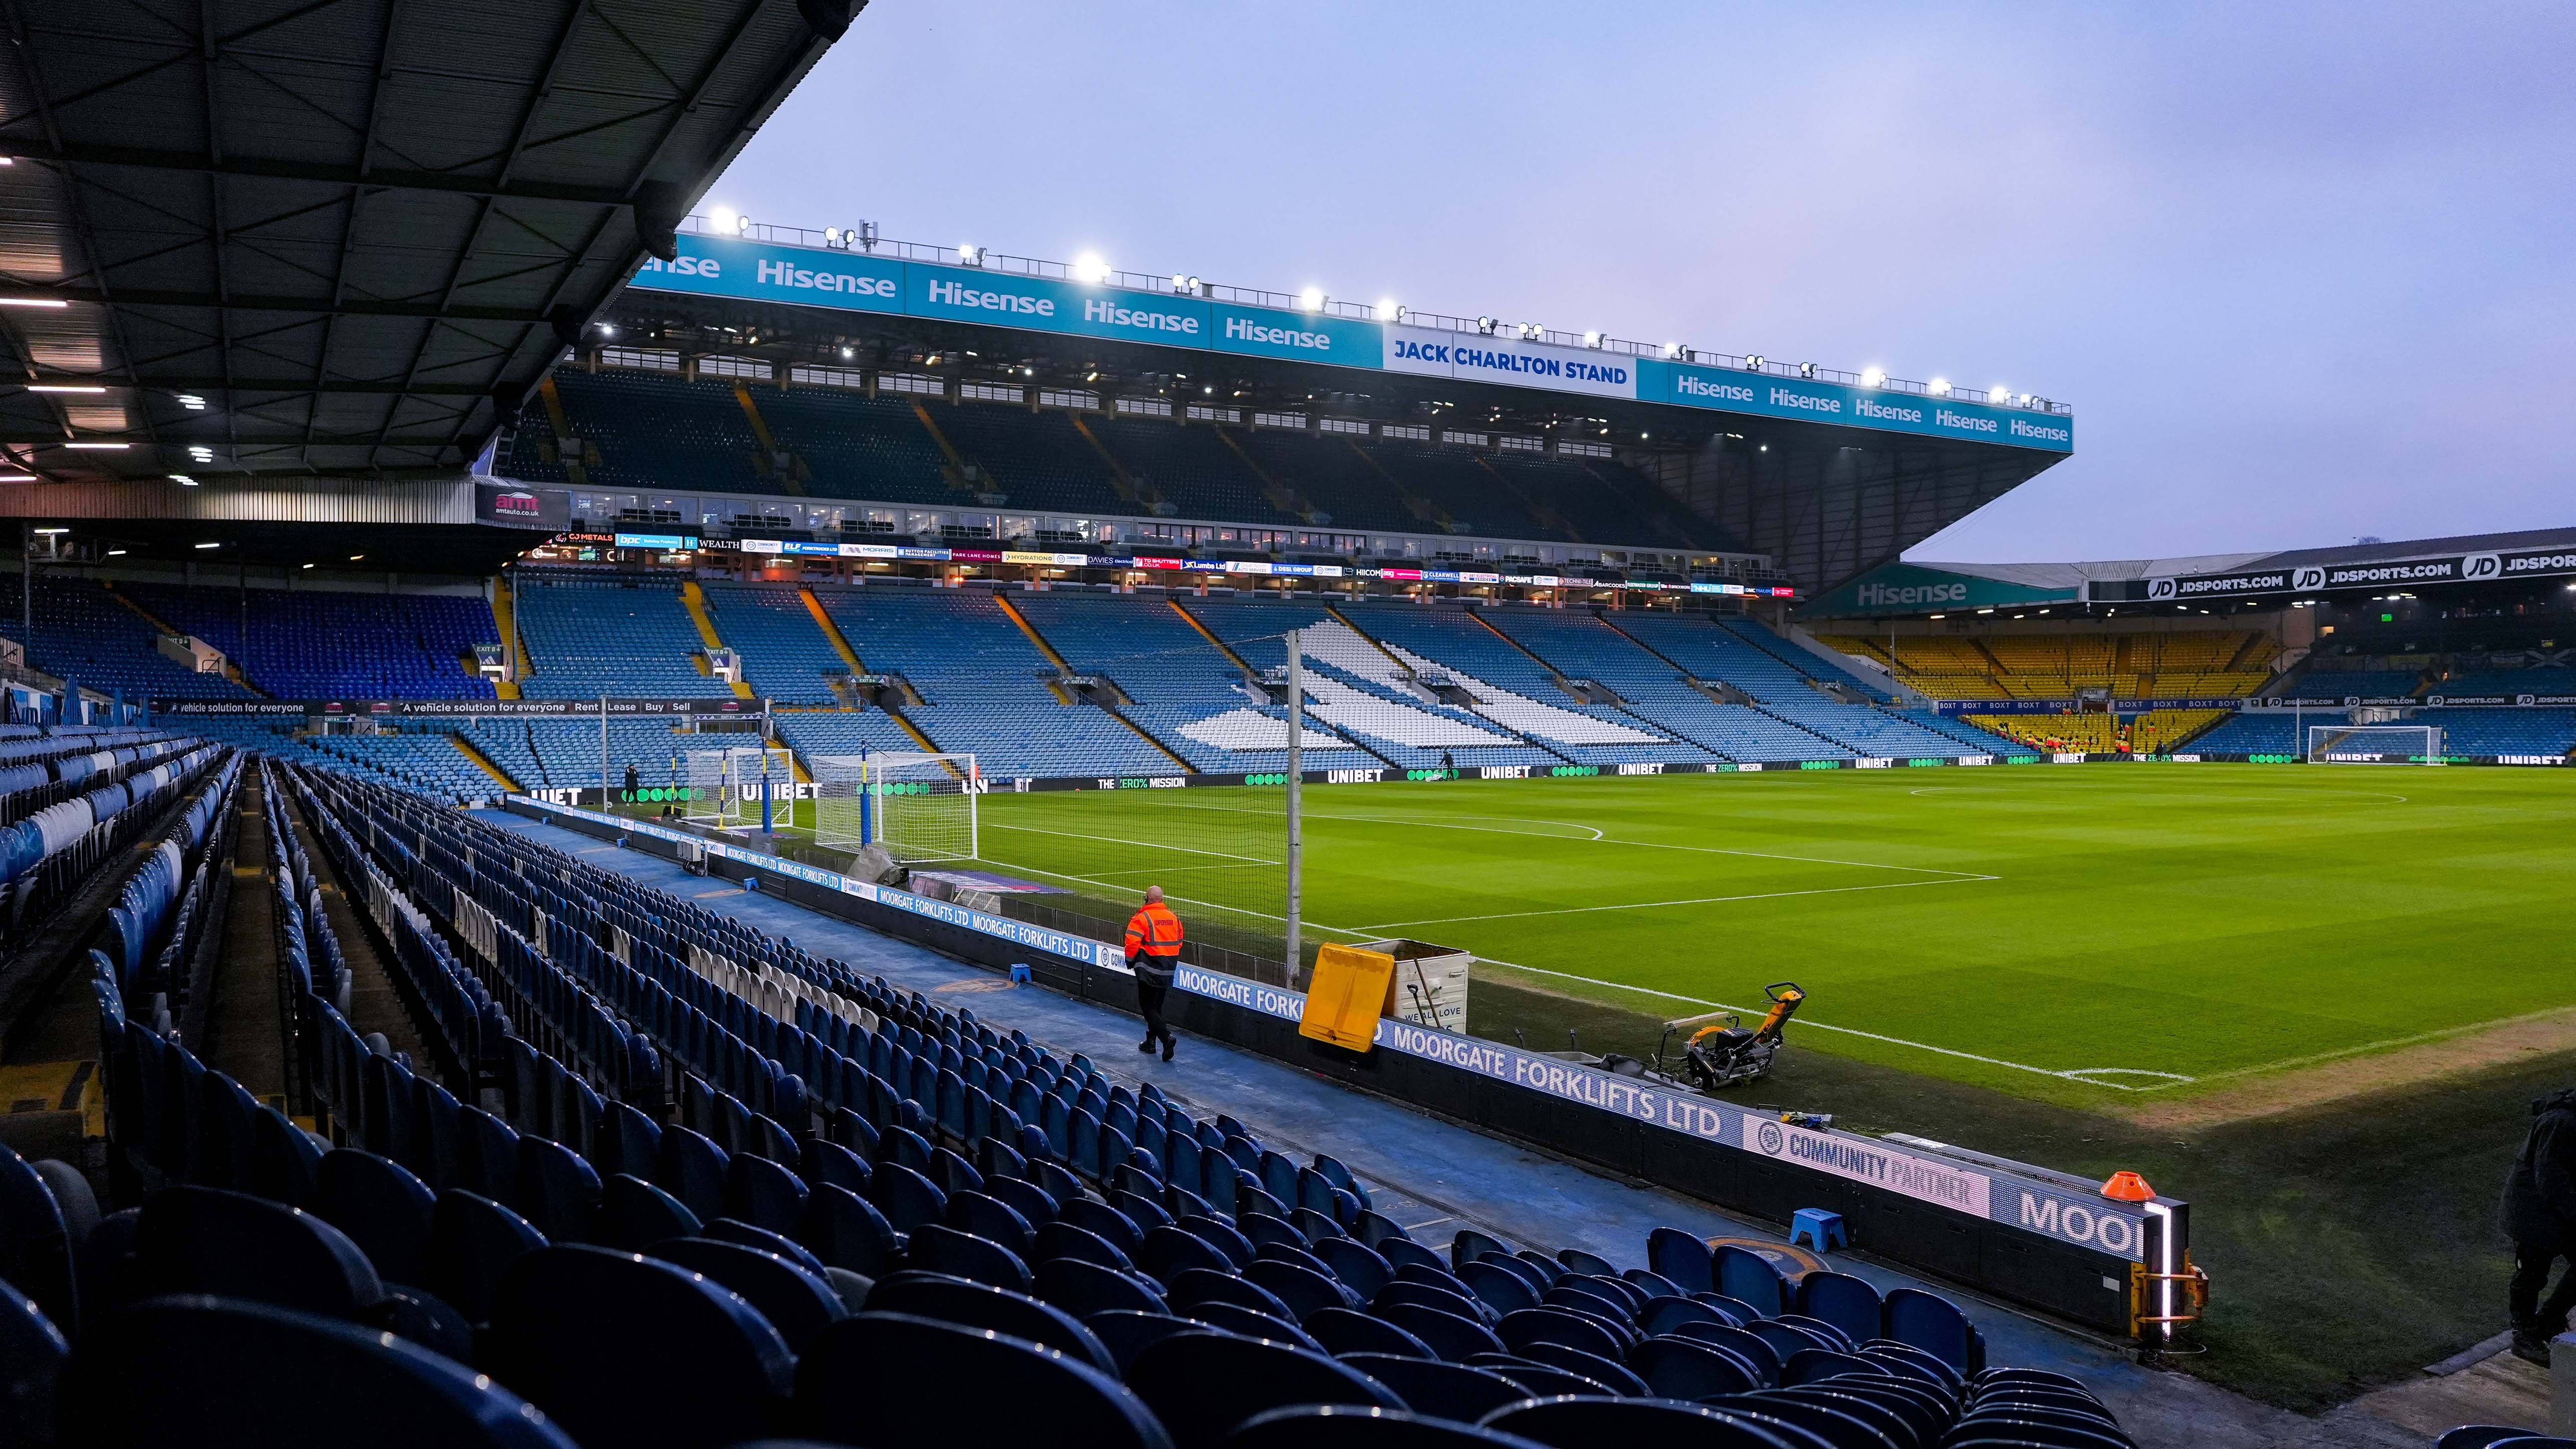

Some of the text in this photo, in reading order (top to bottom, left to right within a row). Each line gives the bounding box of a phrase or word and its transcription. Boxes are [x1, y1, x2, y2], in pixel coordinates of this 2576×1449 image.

[757, 259, 896, 298] Hisense
[929, 279, 1054, 316] Hisense
[1085, 300, 1199, 333] Hisense
[1226, 318, 1331, 349] Hisense
[1394, 340, 1627, 384] JACK CHARLTON STAND
[1678, 375, 1754, 401] Hisense
[1770, 387, 1840, 412] Hisense
[1856, 398, 1921, 423] Hisense
[1936, 409, 1997, 432] Hisense
[2010, 420, 2068, 441] Hisense
[496, 508, 539, 516] amtauto.co.uk
[620, 535, 641, 544] bpc
[699, 540, 740, 549] WEALTH
[2506, 554, 2576, 571] JDSPOR
[2329, 564, 2451, 583] JDSPORTS.COM
[2180, 575, 2283, 593] JDSPORTS.COM
[1857, 583, 1967, 606] Hisense
[180, 703, 304, 714] vehicle solution for everyone
[402, 703, 565, 713] A vehicle solution for everyone
[575, 703, 598, 711] Rent
[608, 703, 636, 711] Lease
[646, 703, 664, 712] Buy
[673, 702, 690, 711] Sell
[1855, 758, 1893, 768] UNIBET
[1959, 756, 1994, 766] UNIBET
[2053, 753, 2086, 763] UNIBET
[2133, 754, 2146, 762] THE
[1481, 766, 1531, 779] UNIBET
[1619, 763, 1664, 775] UNIBET
[1706, 763, 1763, 773] THE ZERO% MISSION
[1098, 779, 1114, 789] THE
[1150, 777, 1186, 788] MISSION
[1328, 769, 1383, 783] UNIBET
[727, 847, 746, 861] MOORGATE
[747, 853, 768, 868] FORKLIFTS
[768, 860, 776, 870] LTD
[778, 861, 801, 877] MOORGATE
[802, 868, 827, 885] FORKLIFTS
[828, 875, 838, 888] LTD
[880, 890, 1090, 960] MOORGATE FORKLIFTS LTD MOORGATE FORKLIFTS LTD
[1179, 969, 1251, 1005] MOORGATE
[1405, 1013, 1419, 1021] WE
[1439, 1007, 1461, 1017] LOVE
[1394, 1025, 1722, 1137] MOORGATE FORKLIFTS LTD
[1789, 1132, 1970, 1204] COMMUNITY PARTNER
